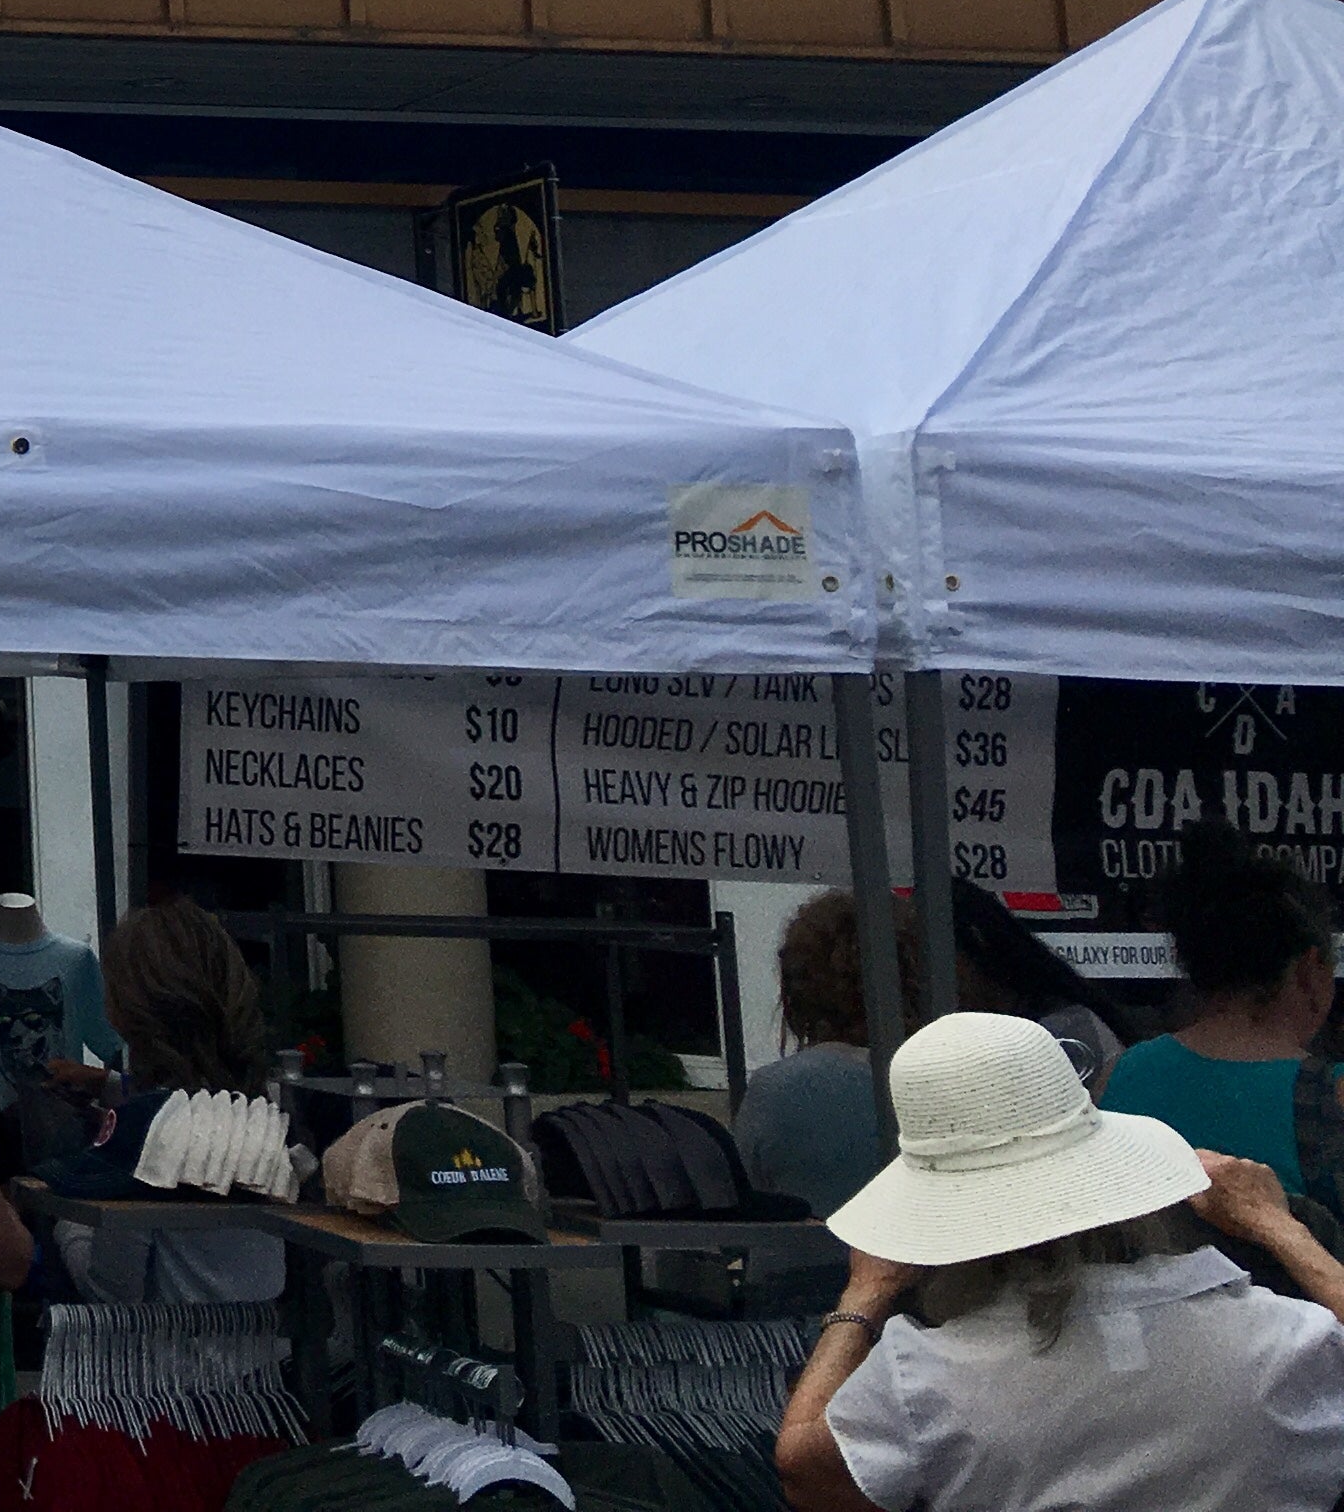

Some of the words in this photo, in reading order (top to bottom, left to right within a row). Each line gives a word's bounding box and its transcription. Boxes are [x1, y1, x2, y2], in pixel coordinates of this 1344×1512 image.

[675, 531, 805, 554] PROSHADE
[207, 692, 361, 734] KEYCHAINS
[465, 705, 519, 744] $10
[960, 674, 1012, 711] $28
[583, 713, 693, 752] HOODED
[726, 721, 811, 758] SOLAR
[956, 730, 1007, 768] $36
[206, 748, 365, 792] NECKLACES
[469, 761, 523, 802] $20
[584, 768, 671, 806] HEAVY
[681, 773, 698, 808] &
[707, 774, 746, 809] ZIP
[953, 787, 1006, 823] $45
[1099, 769, 1202, 831] CDA
[206, 807, 275, 847] HATS
[284, 811, 301, 848] &
[311, 813, 424, 855] BEANIES
[468, 820, 522, 861] $28
[588, 827, 705, 866] WOMENS
[714, 833, 805, 871] FLOWY
[955, 844, 1008, 880] $28
[1112, 946, 1138, 964] FOR
[1141, 946, 1166, 964] OUR
